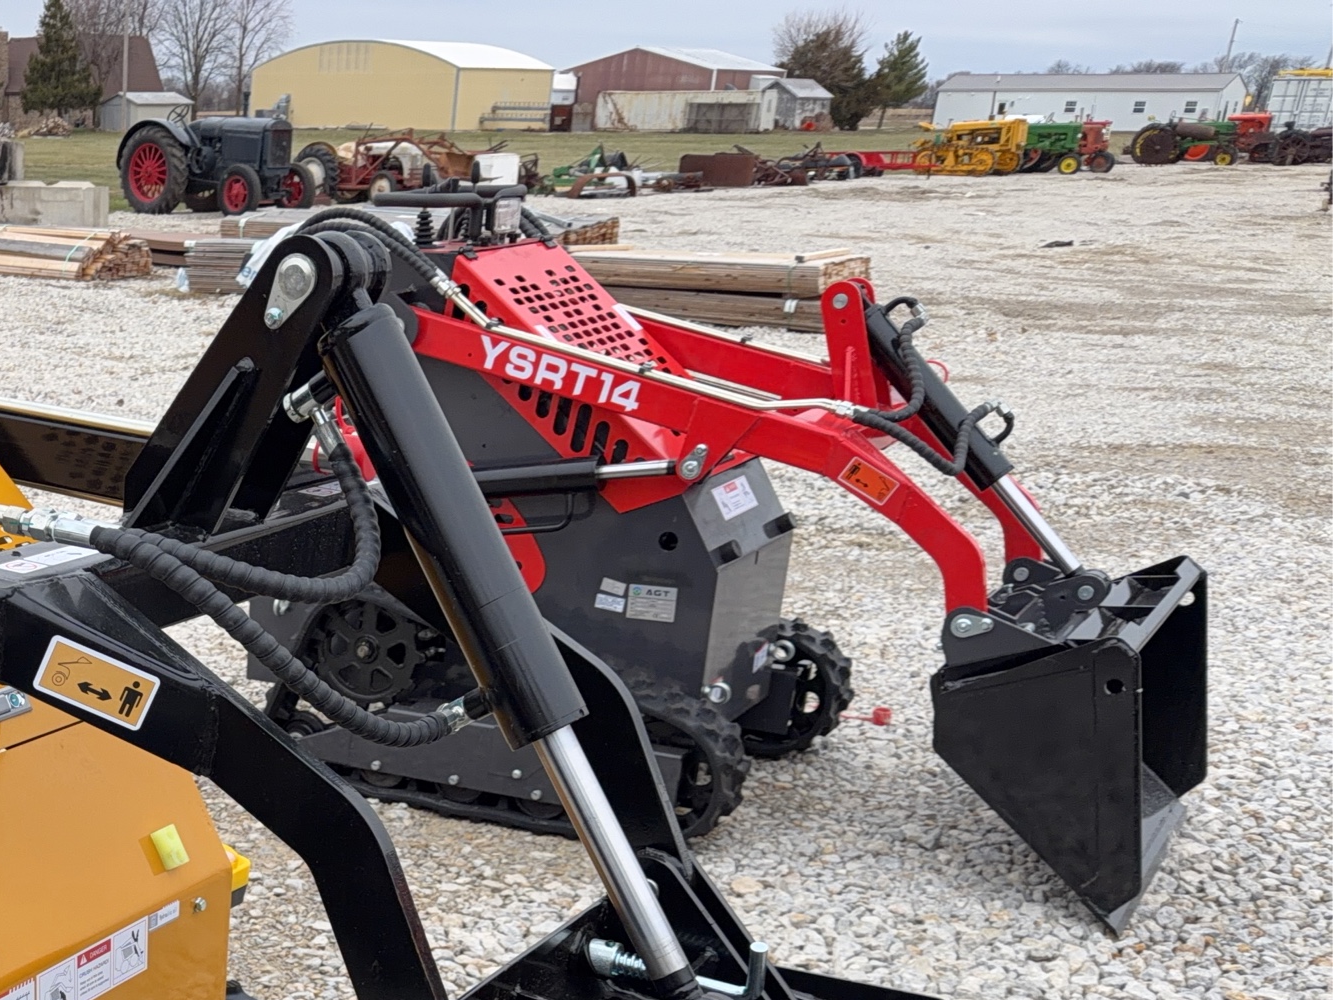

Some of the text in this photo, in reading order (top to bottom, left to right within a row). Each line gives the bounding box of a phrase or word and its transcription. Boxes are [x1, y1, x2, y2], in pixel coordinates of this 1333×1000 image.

[480, 334, 642, 412] YSRT14
[646, 589, 670, 597] AGT
[89, 944, 108, 959] DANGER
